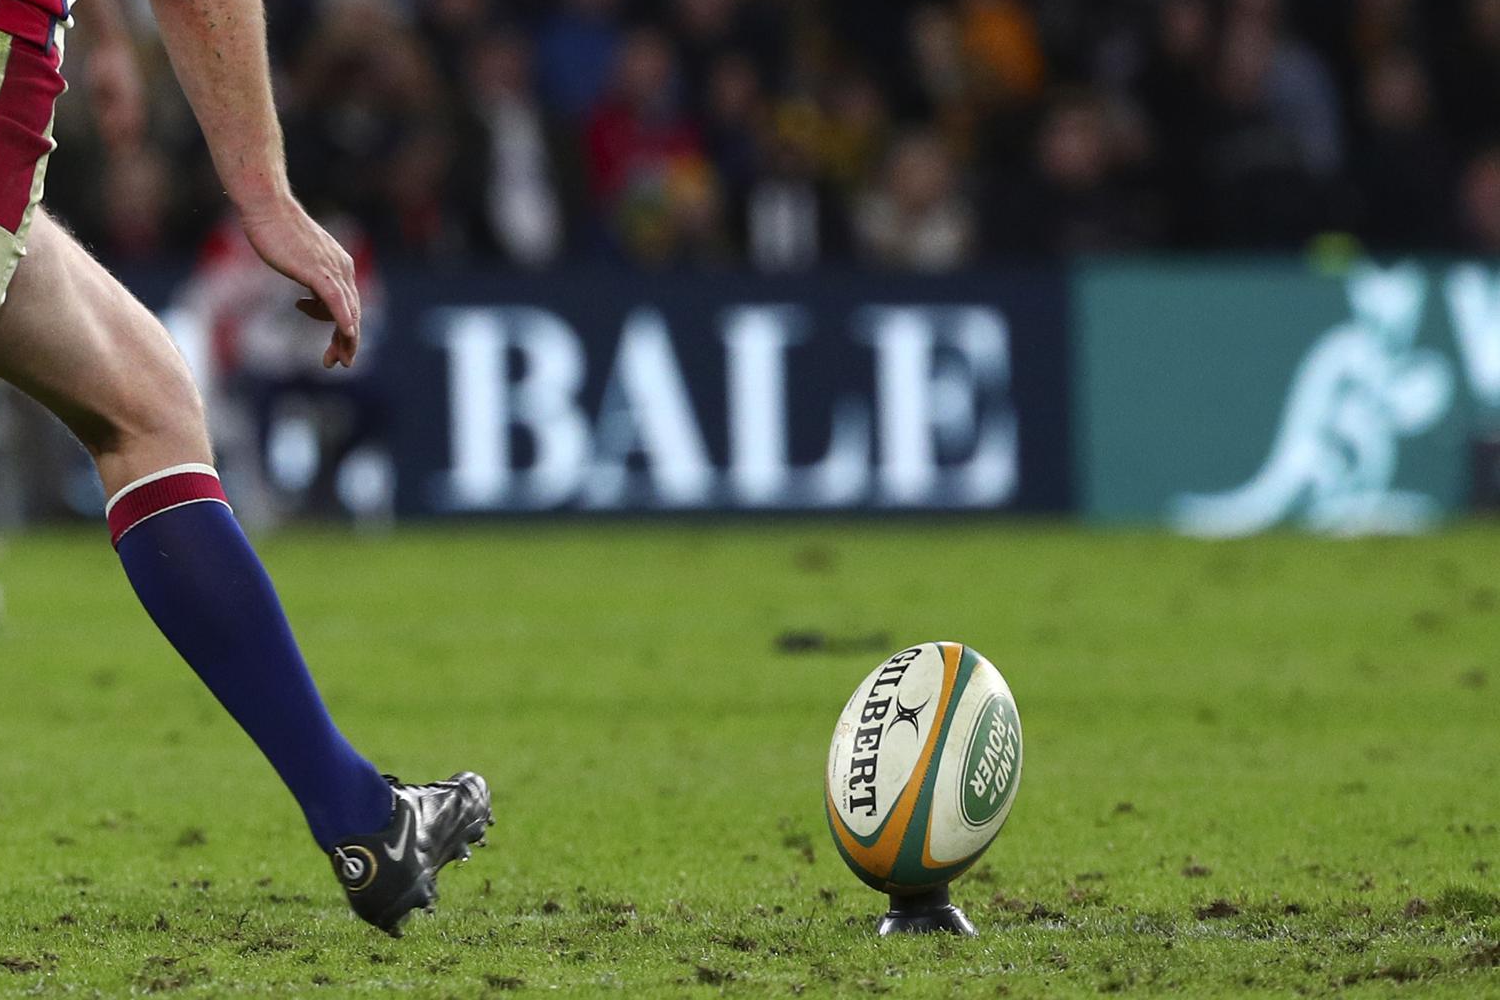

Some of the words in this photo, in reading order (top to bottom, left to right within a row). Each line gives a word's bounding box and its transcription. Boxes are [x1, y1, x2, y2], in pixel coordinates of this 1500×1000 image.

[418, 303, 1019, 510] BALE
[849, 647, 922, 817] GILBERT
[969, 710, 1007, 799] ROVER
[994, 721, 1019, 794] LAND
